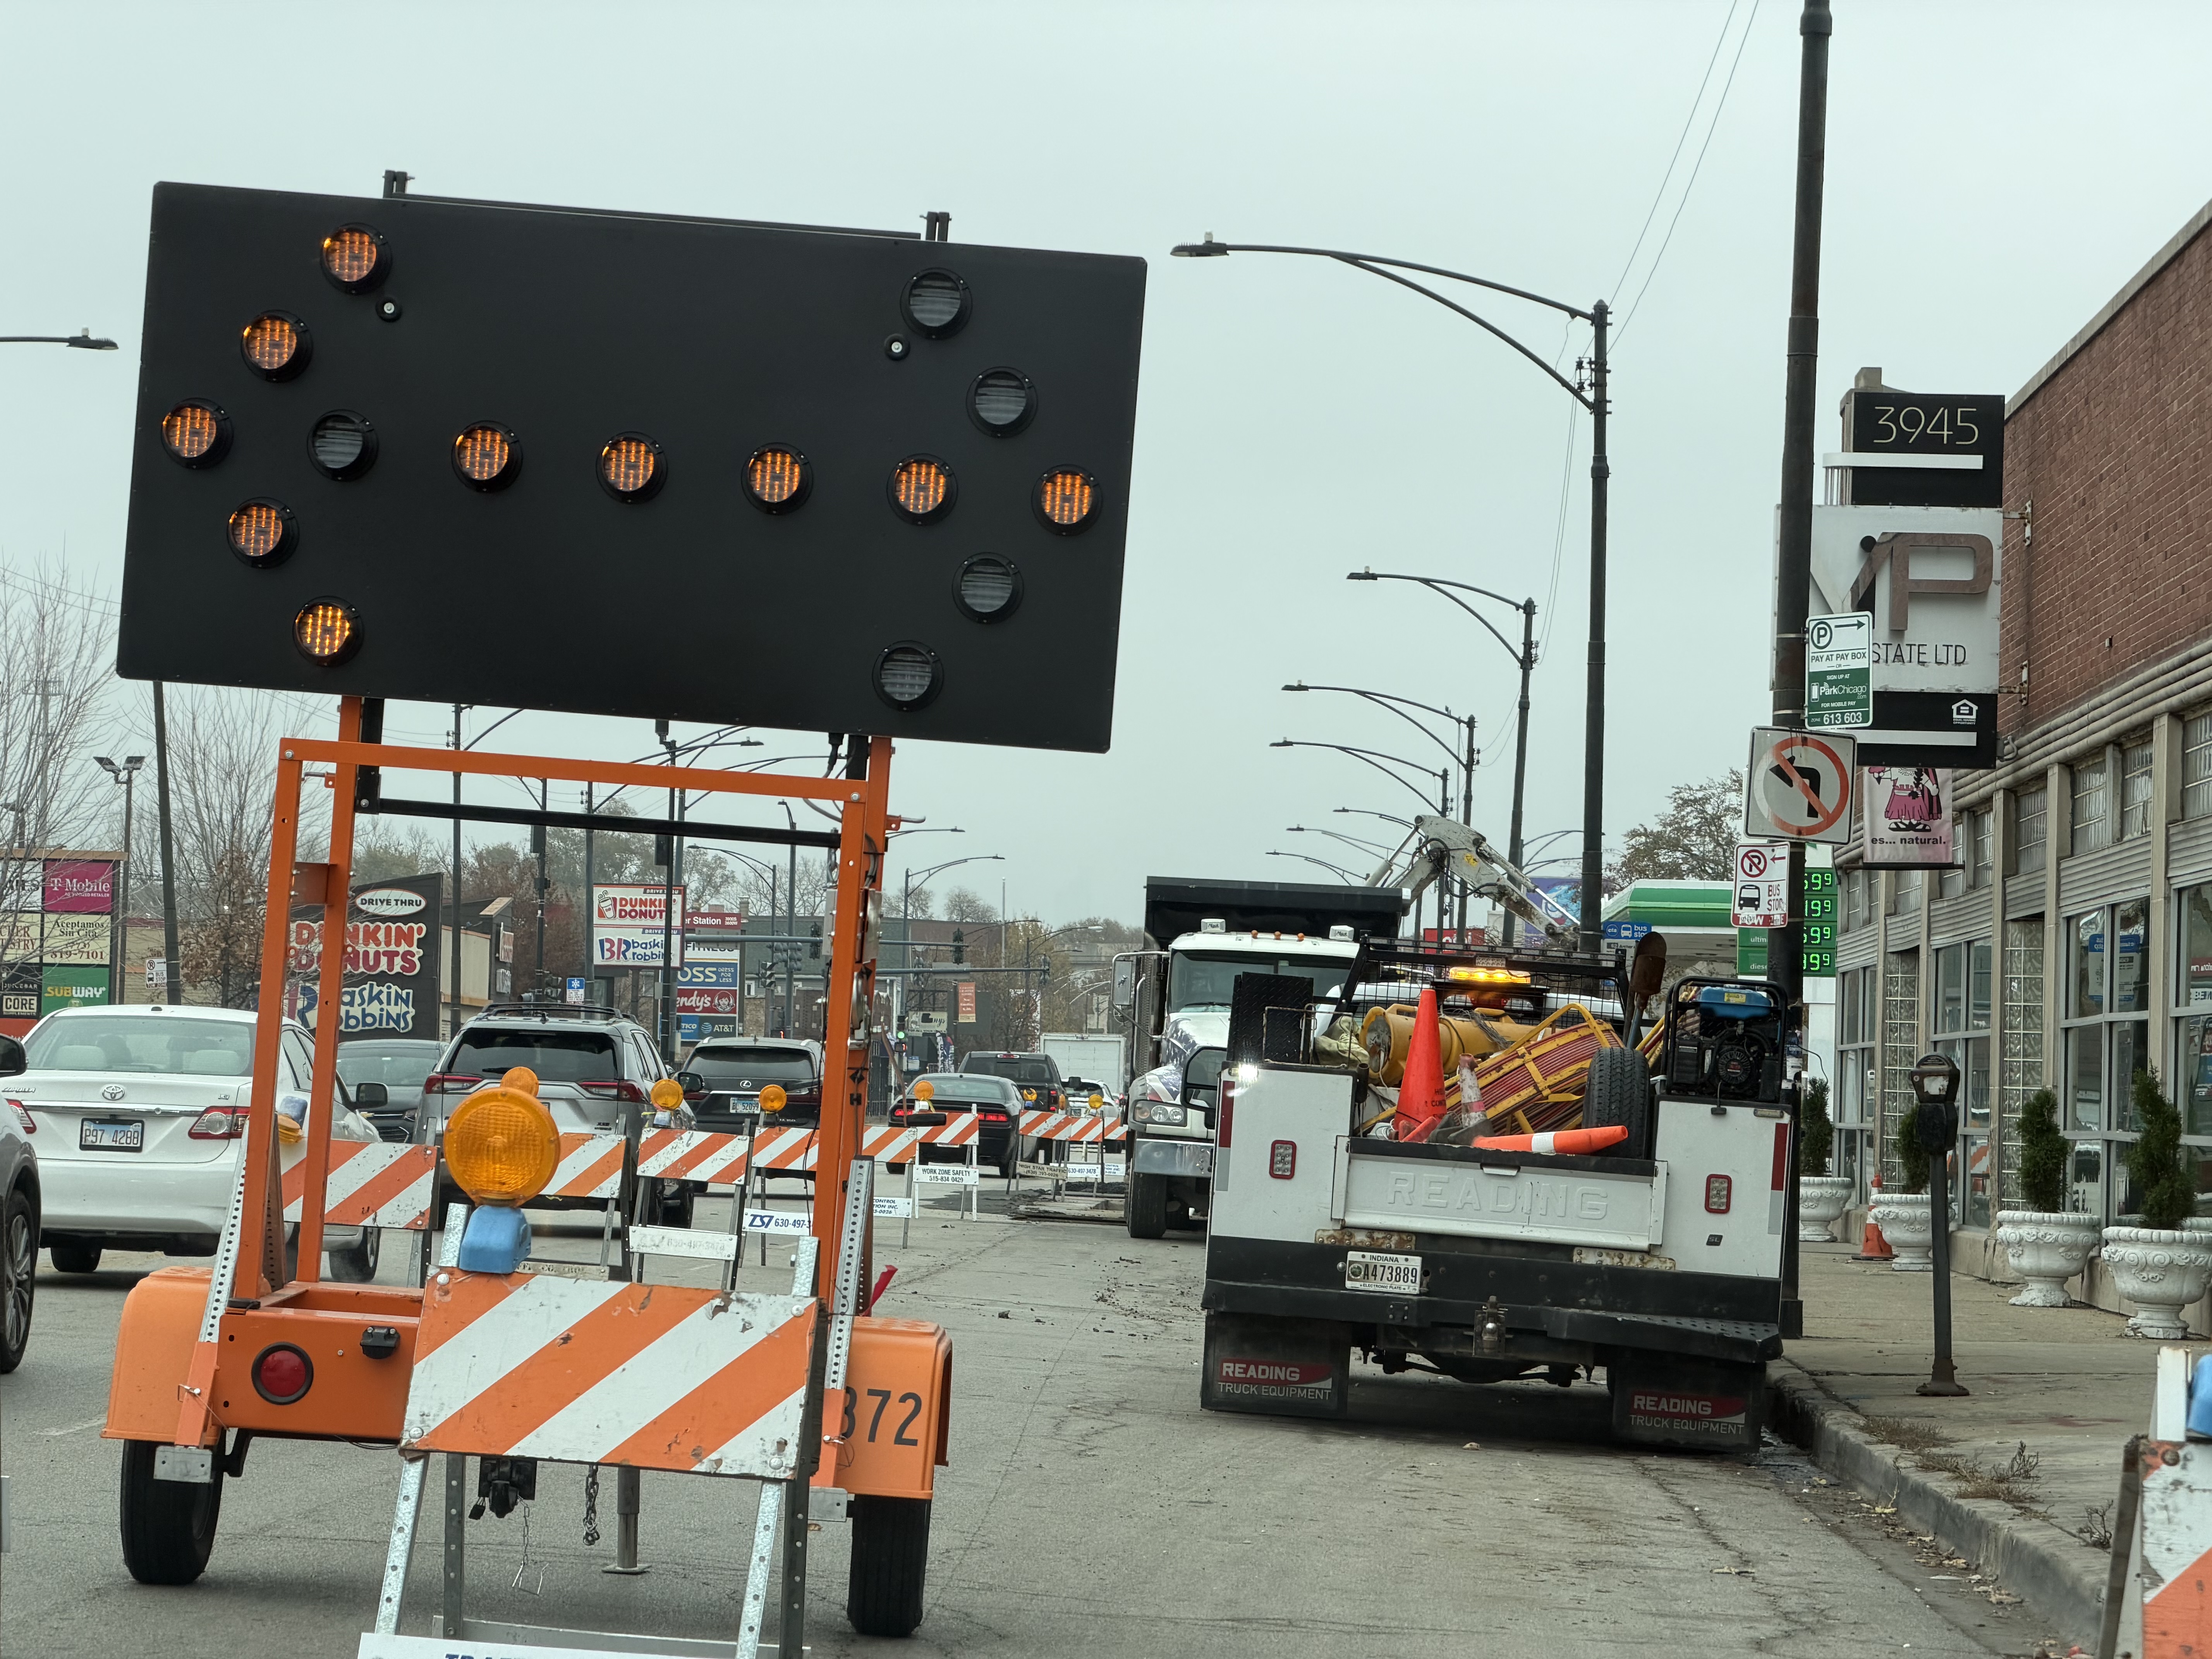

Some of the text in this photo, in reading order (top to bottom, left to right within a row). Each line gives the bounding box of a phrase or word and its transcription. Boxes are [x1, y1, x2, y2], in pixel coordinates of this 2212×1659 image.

[1874, 406, 1979, 445] 3945
[1836, 653, 1850, 661] PAY
[1851, 651, 1867, 659] BOX
[1872, 643, 1966, 664] STATE LTD
[1820, 685, 1867, 696] ParkChicago
[1823, 713, 1841, 724] 613
[1844, 712, 1862, 723] 603
[1900, 836, 1946, 844] natural.
[65, 879, 110, 892] Mobile
[1768, 884, 1780, 897] BUS
[394, 899, 422, 907] THRU
[1767, 898, 1784, 911] STOP
[618, 908, 665, 919] DONUT
[54, 921, 104, 929] Aceptamos
[693, 916, 721, 925] Station
[295, 923, 423, 948] DNKIN'
[51, 951, 103, 959] 819-7101
[599, 938, 664, 960] BR baski
[295, 950, 416, 974] DNUTS
[678, 967, 716, 982] OSS
[45, 986, 106, 998] SUBWAY
[341, 983, 412, 1008] askin
[5, 998, 35, 1010] CORE
[677, 991, 711, 1012] endy's
[84, 1128, 139, 1145] P97 4288
[1388, 1171, 1608, 1220] READING
[775, 1218, 811, 1228] 630-497-3
[1370, 1255, 1399, 1263] INDIANA
[1363, 1264, 1417, 1284] A473889
[1222, 1362, 1300, 1381] READING
[1218, 1382, 1331, 1400] TRUCK EQUIPMENT
[1633, 1395, 1712, 1415] READING
[1630, 1415, 1744, 1435] TRUCK EQUIPMENT
